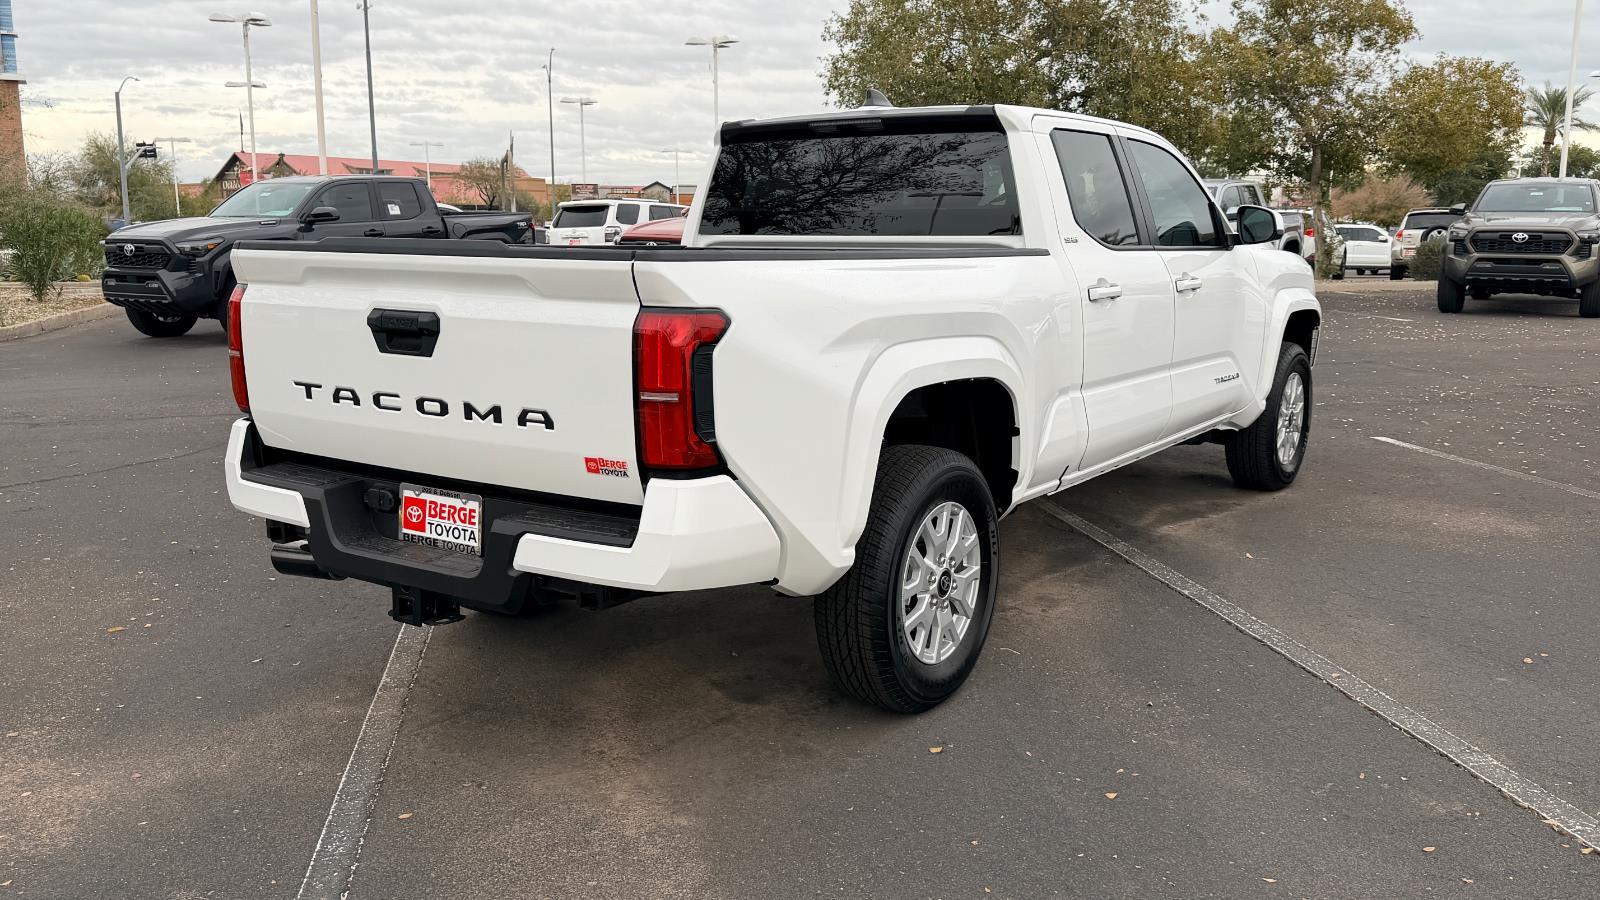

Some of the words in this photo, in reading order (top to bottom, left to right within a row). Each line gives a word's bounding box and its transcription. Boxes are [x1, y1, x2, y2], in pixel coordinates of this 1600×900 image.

[293, 380, 555, 431] TACOMA
[598, 457, 628, 470] BERGE
[600, 468, 629, 478] TOYOTA
[428, 500, 477, 526] BERGE
[427, 522, 478, 543] TOYOTA
[402, 533, 439, 548] BERGE
[442, 540, 477, 555] TOYOTA
